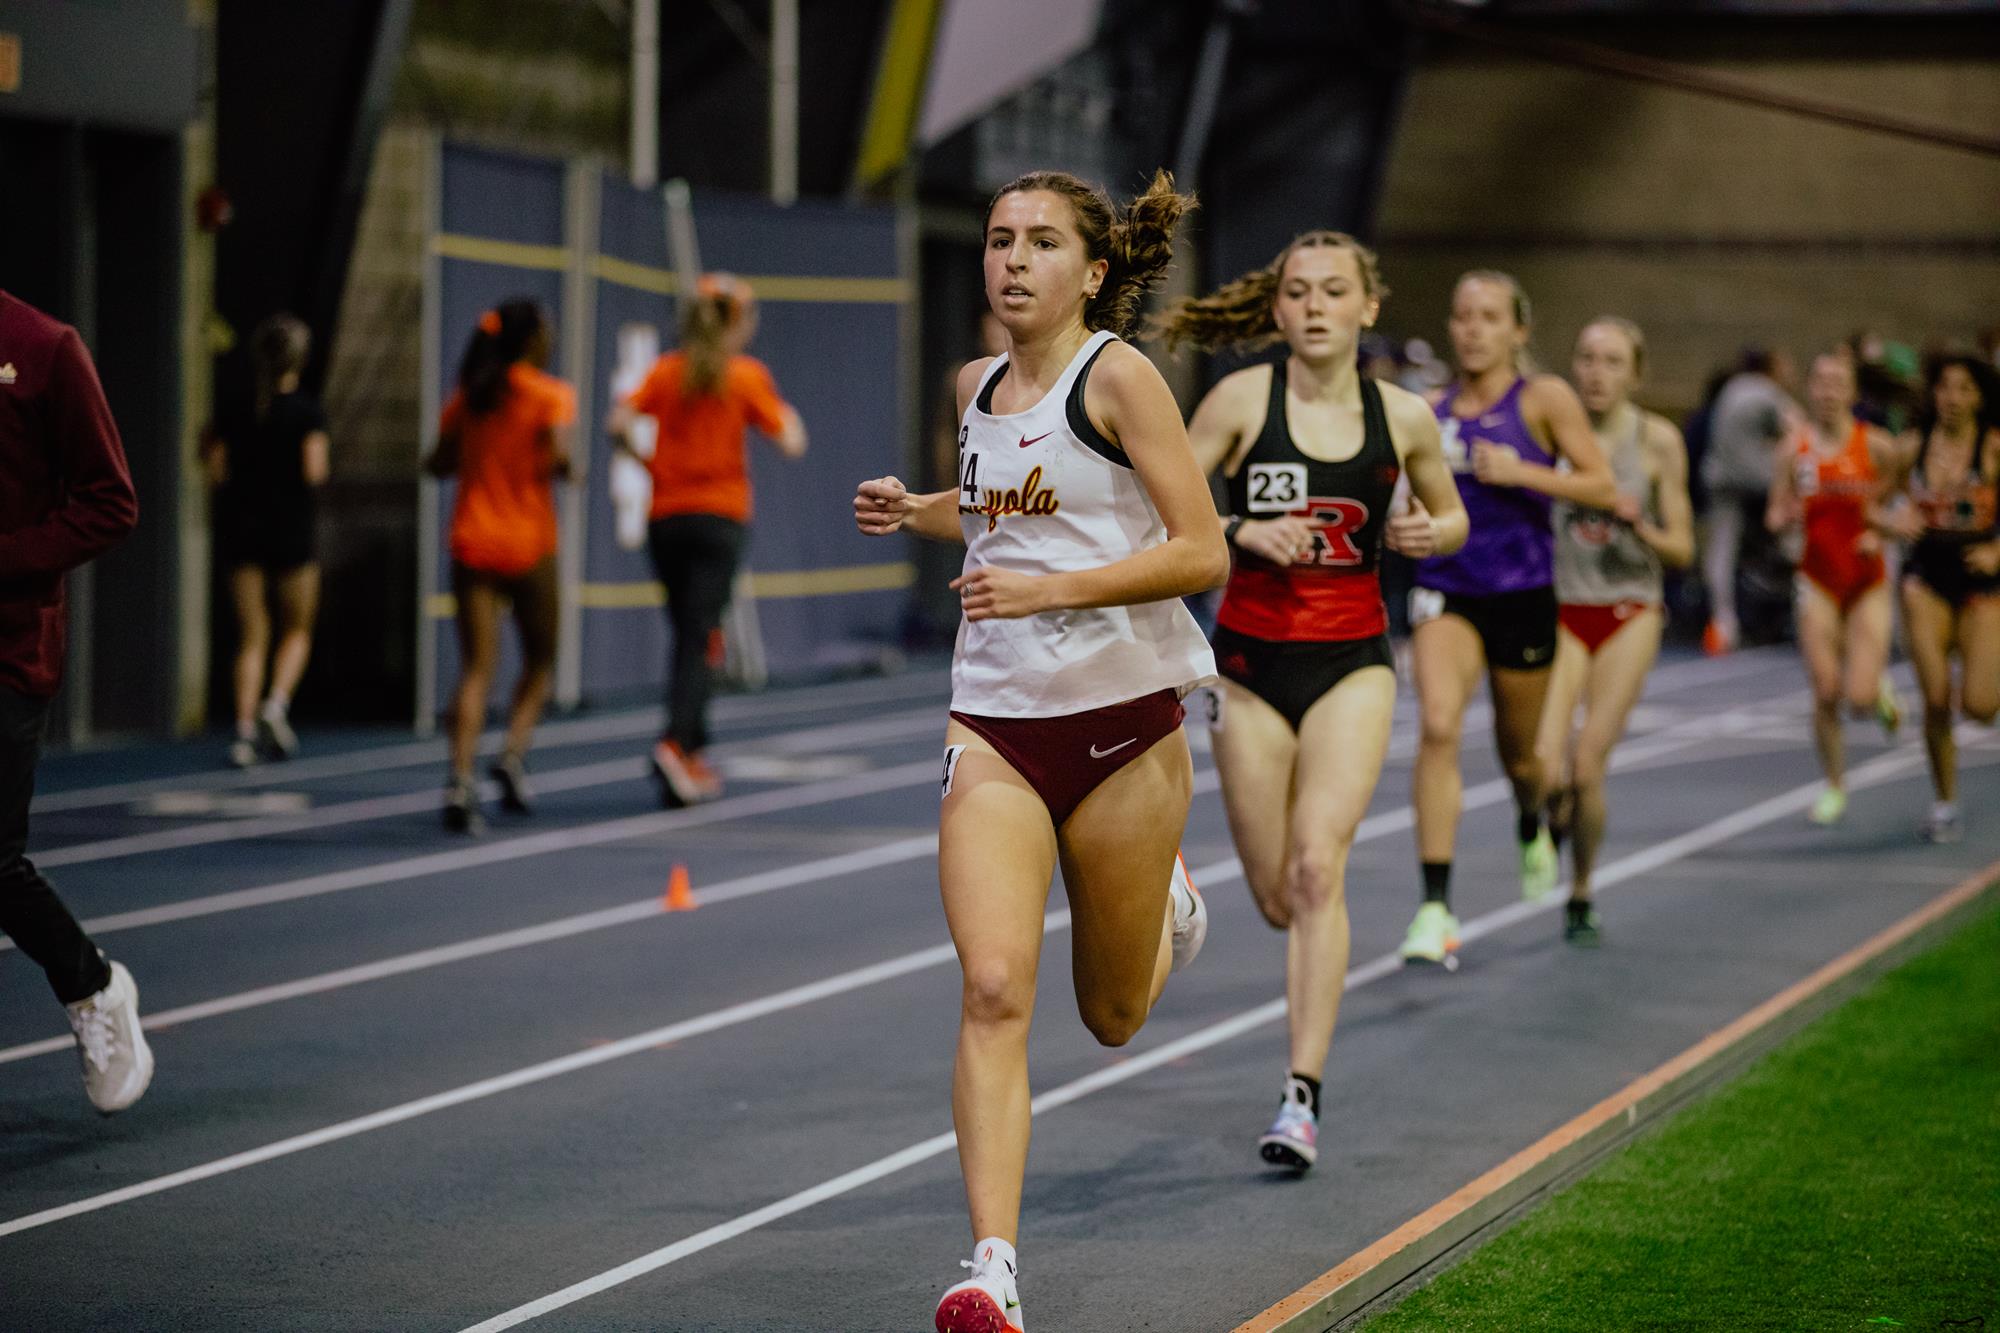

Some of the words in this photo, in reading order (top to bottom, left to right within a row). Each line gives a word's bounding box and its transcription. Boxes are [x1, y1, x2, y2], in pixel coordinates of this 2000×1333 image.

[959, 465, 1059, 533] yola
[1253, 472, 1297, 502] 23
[1286, 496, 1369, 566] R
